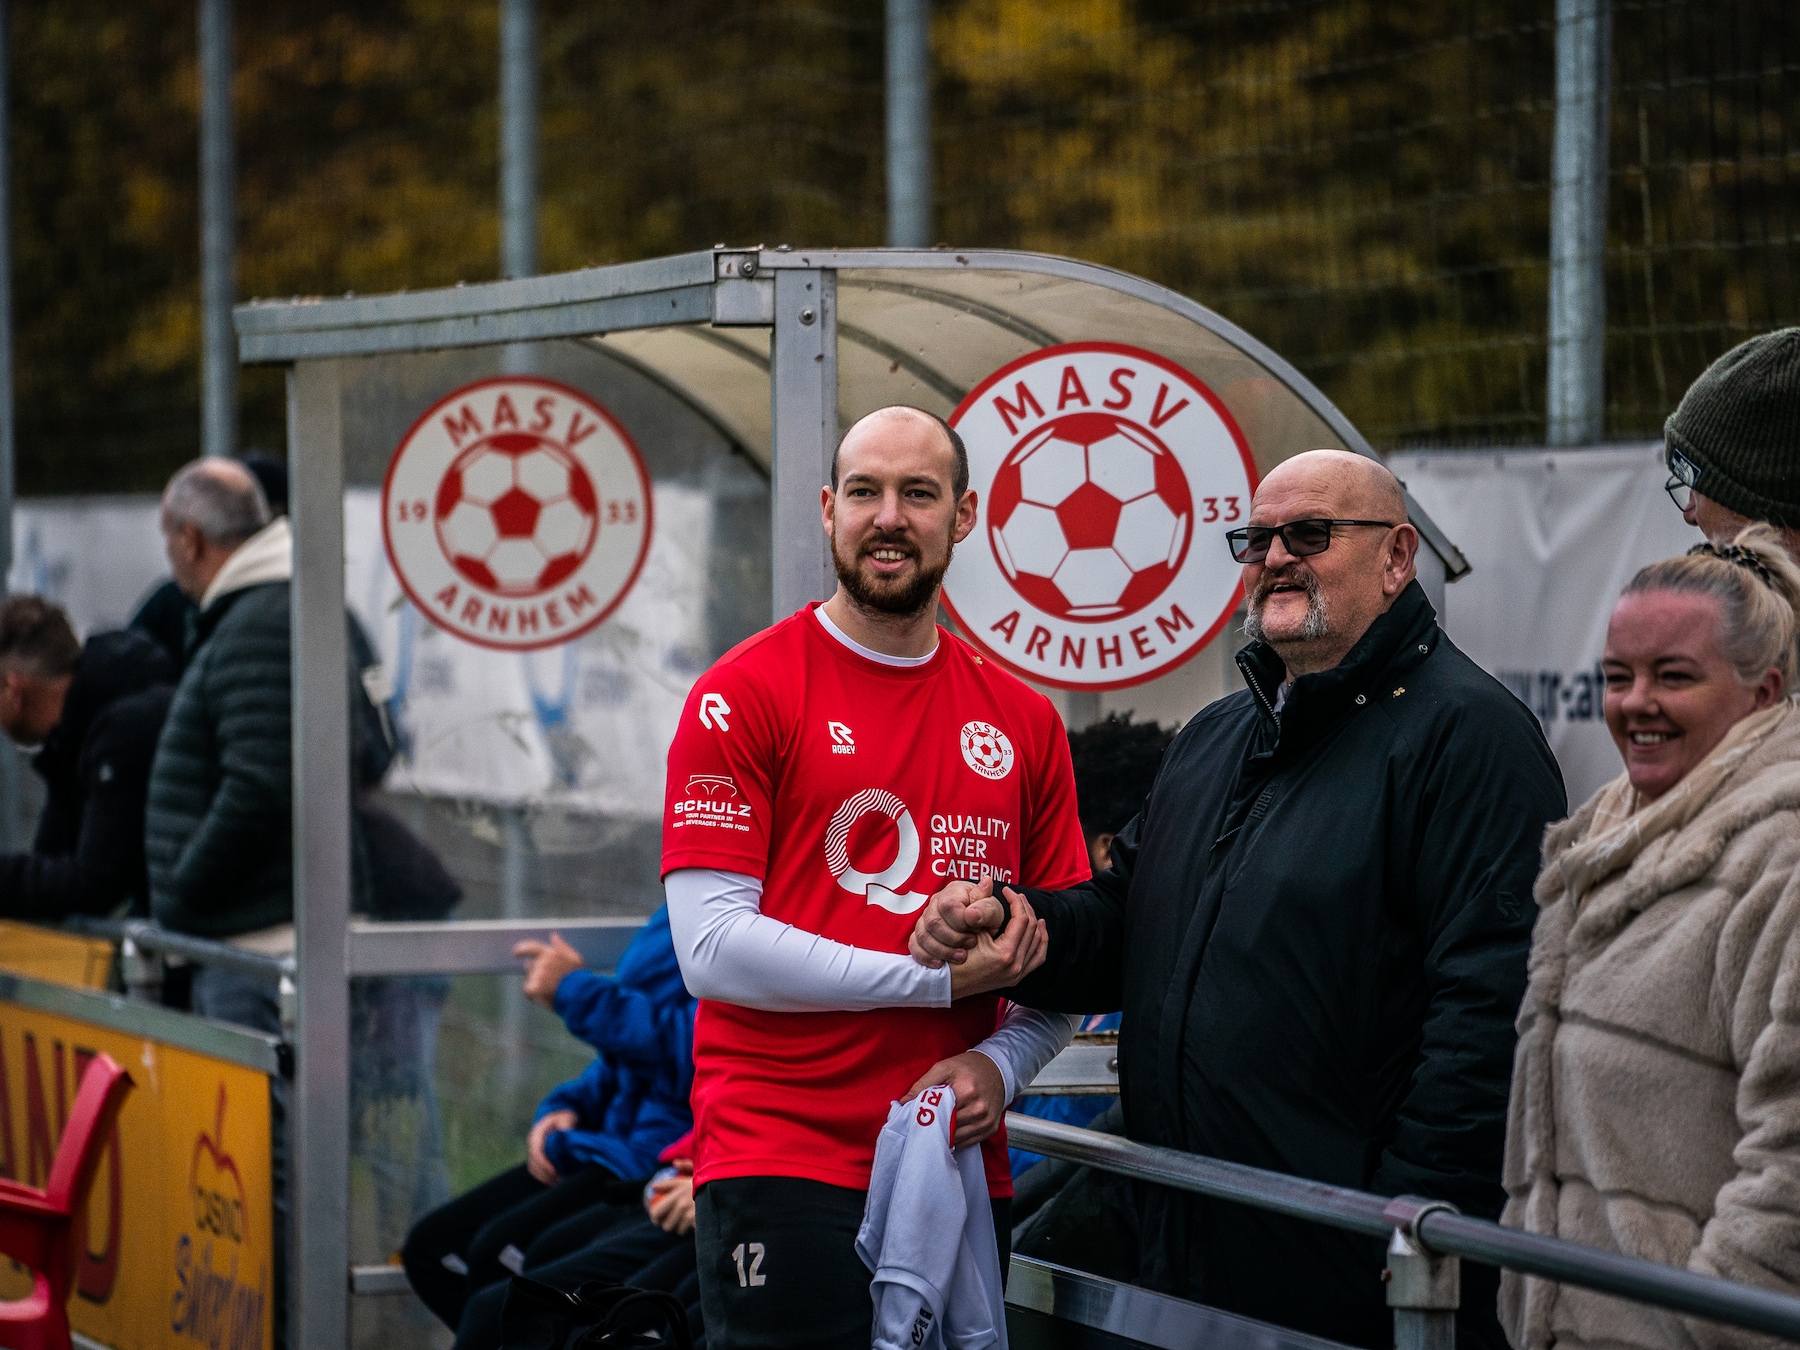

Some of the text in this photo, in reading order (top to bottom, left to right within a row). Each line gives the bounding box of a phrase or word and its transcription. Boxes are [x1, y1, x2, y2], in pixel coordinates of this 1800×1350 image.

[992, 365, 1191, 437] MASV
[441, 393, 599, 449] MASV
[398, 501, 428, 524] 19
[1202, 497, 1241, 523] 33
[435, 583, 597, 635] ARNHEM
[990, 603, 1196, 670] ARNHEM
[962, 723, 1003, 738] MASV
[832, 744, 856, 755] ROBEY
[972, 763, 1007, 777] ARNHEM
[674, 800, 752, 817] SCHULZ
[700, 813, 726, 821] PARTNER
[930, 814, 1011, 841] QUALITY
[930, 836, 987, 859] RIVER
[931, 858, 1012, 885] CATERING
[732, 1242, 767, 1288] 12
